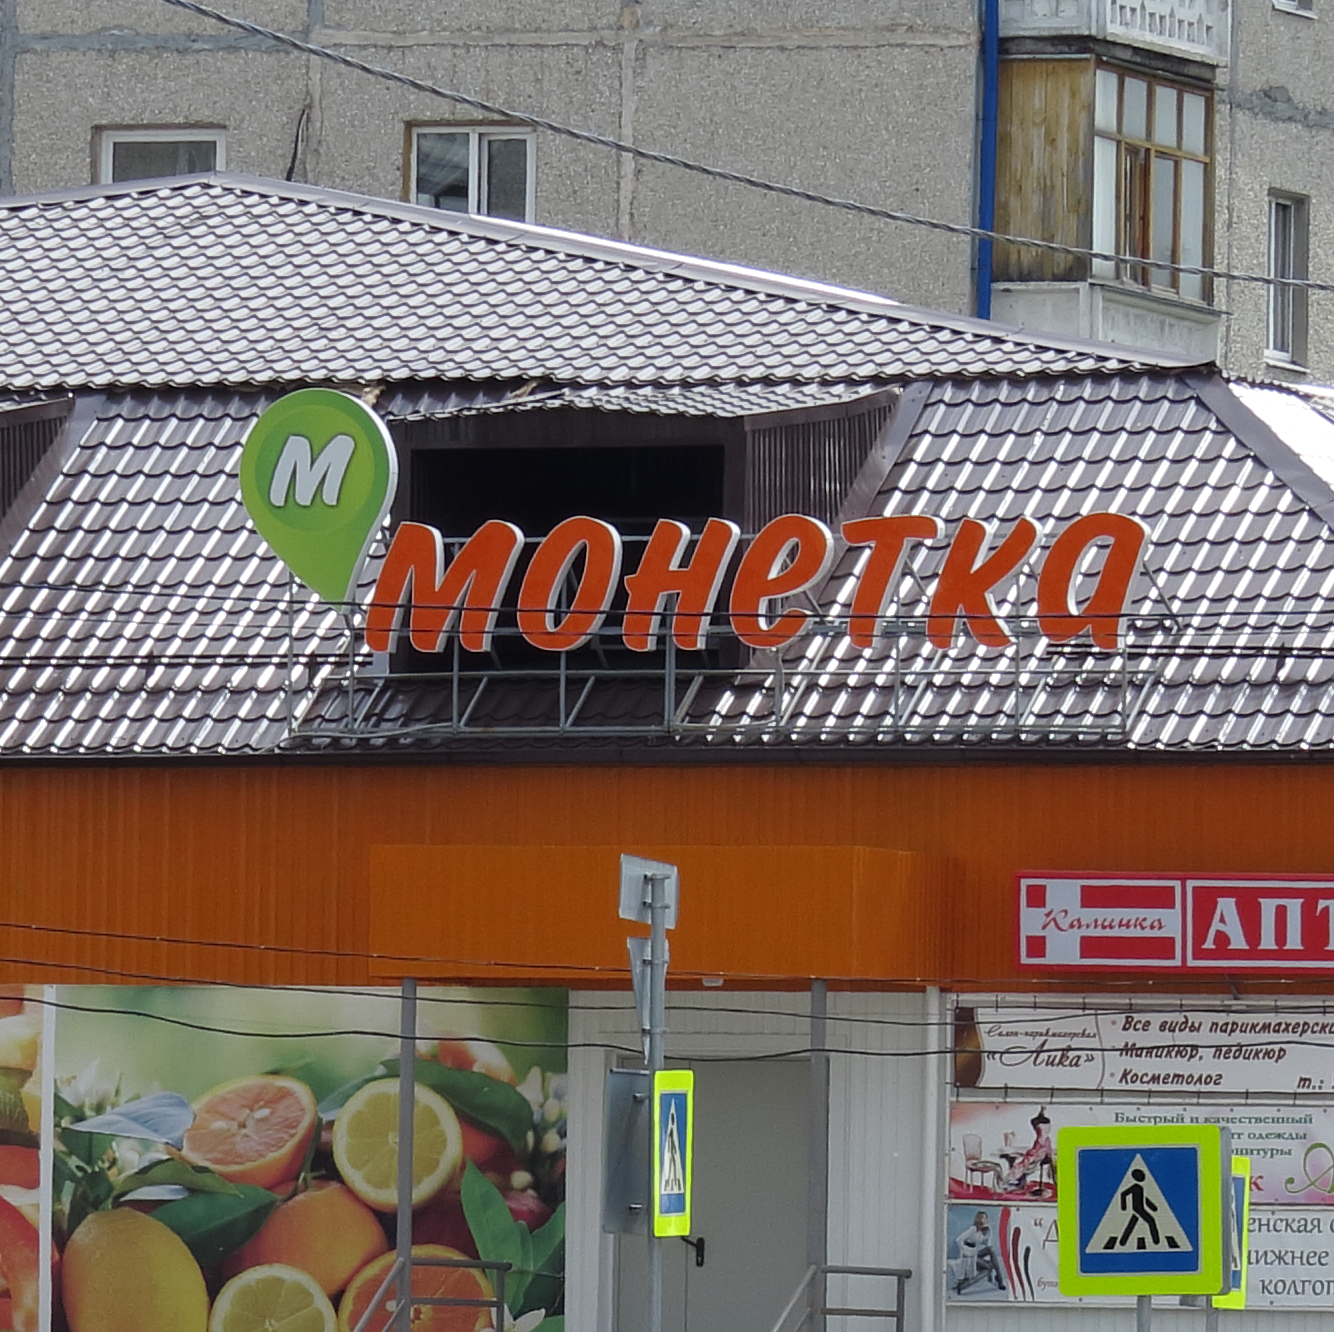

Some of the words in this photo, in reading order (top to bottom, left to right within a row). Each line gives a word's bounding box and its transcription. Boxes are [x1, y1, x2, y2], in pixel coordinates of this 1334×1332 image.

[1041, 908, 1166, 932] Калинка
[1122, 1016, 1151, 1032] Все
[1159, 1015, 1203, 1034] виды
[1119, 1042, 1204, 1062] Маникюр,
[1213, 1043, 1287, 1063] педикюр
[1118, 1069, 1223, 1086] Косметолог
[1114, 1112, 1185, 1126] Быстрый
[1190, 1115, 1200, 1124] и
[1204, 1113, 1313, 1125] качественный
[1247, 1131, 1307, 1141] одежды
[1248, 1216, 1322, 1234] енская
